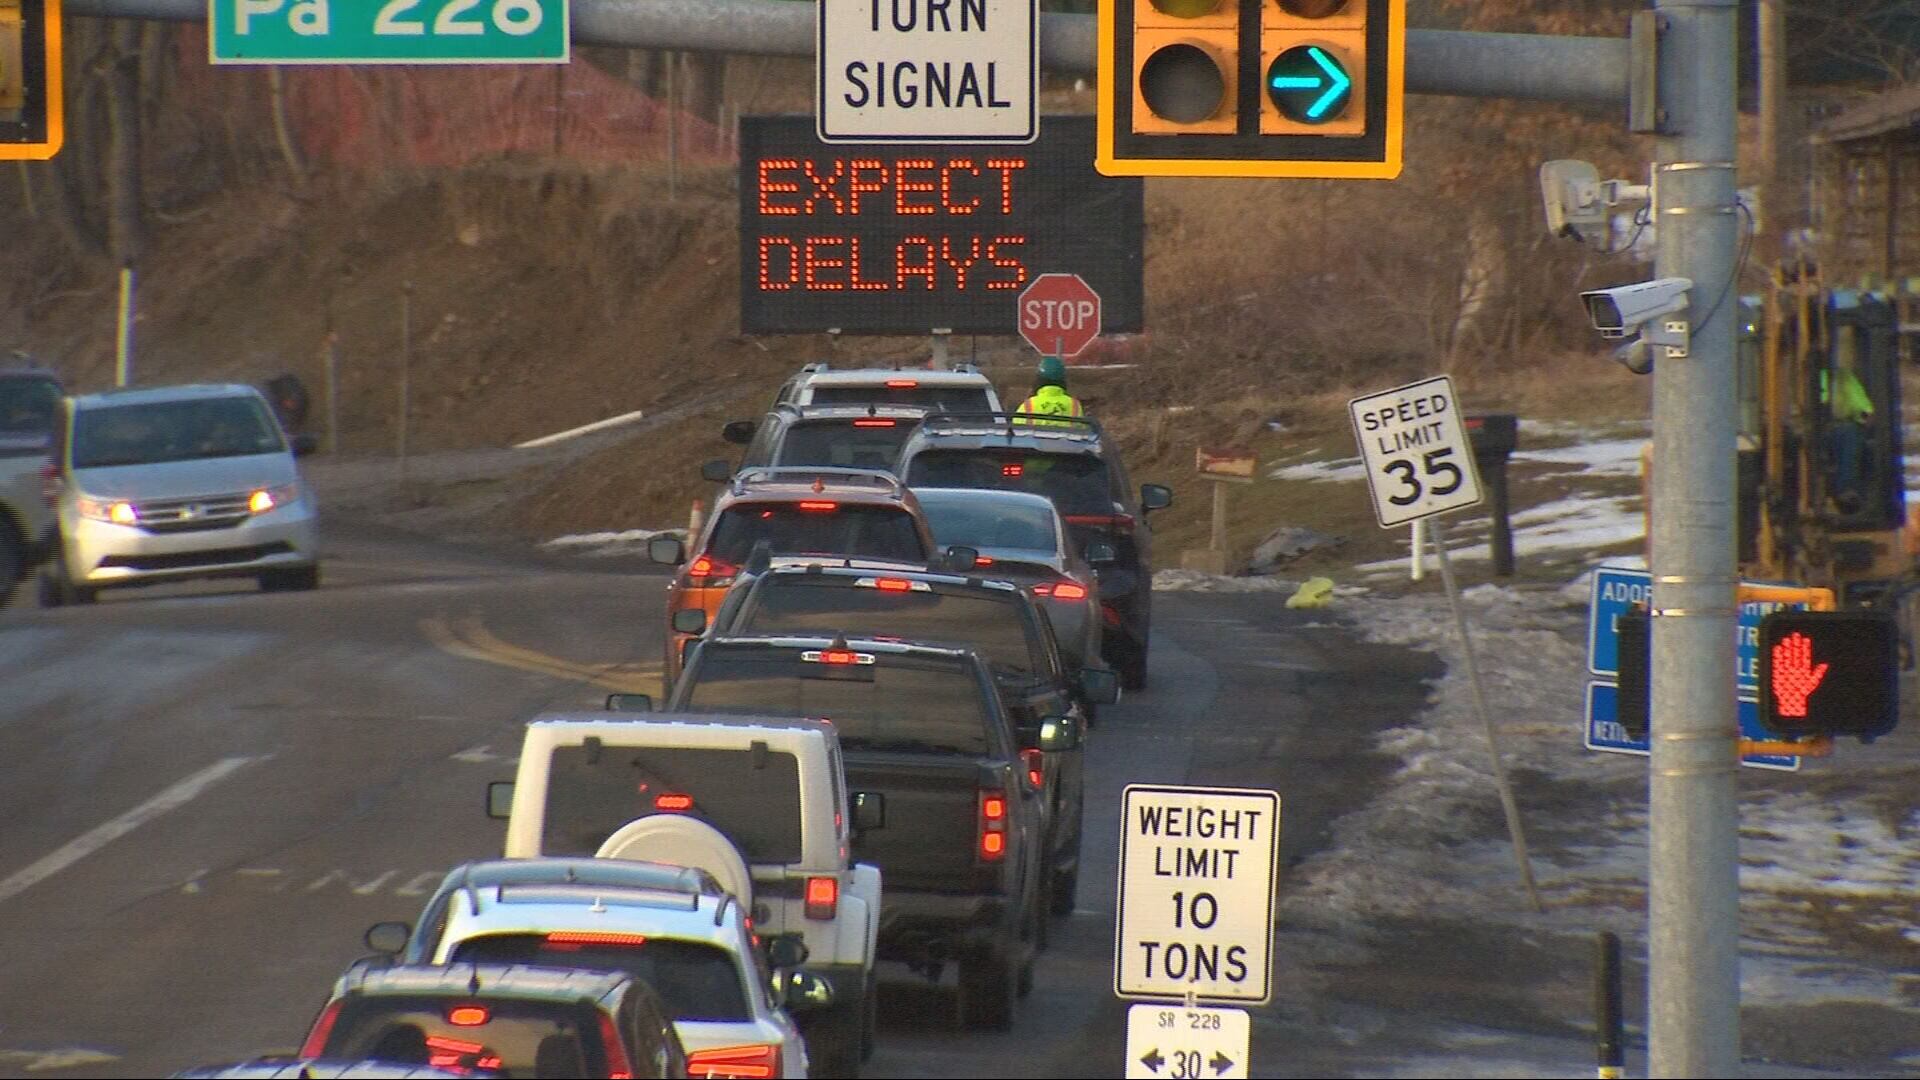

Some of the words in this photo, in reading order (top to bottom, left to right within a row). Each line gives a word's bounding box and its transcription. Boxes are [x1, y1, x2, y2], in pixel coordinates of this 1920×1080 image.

[871, 0, 987, 32] TURN
[844, 61, 1011, 108] SIGNAL
[757, 158, 1027, 216] EXPECT
[757, 236, 1026, 291] DELAYS
[1024, 300, 1095, 330] STOP
[1363, 394, 1448, 431] SPEED
[1378, 422, 1443, 455] LIMIT
[1383, 447, 1463, 506] 35
[1601, 581, 1652, 603] ADOP
[1139, 805, 1262, 840] WEIGHT
[1155, 846, 1240, 879] LIMIT
[1172, 891, 1218, 930] 10
[1139, 941, 1247, 982] TONS
[1158, 1011, 1175, 1028] SR
[1190, 1013, 1221, 1030] 228
[1171, 1050, 1202, 1079] 30
